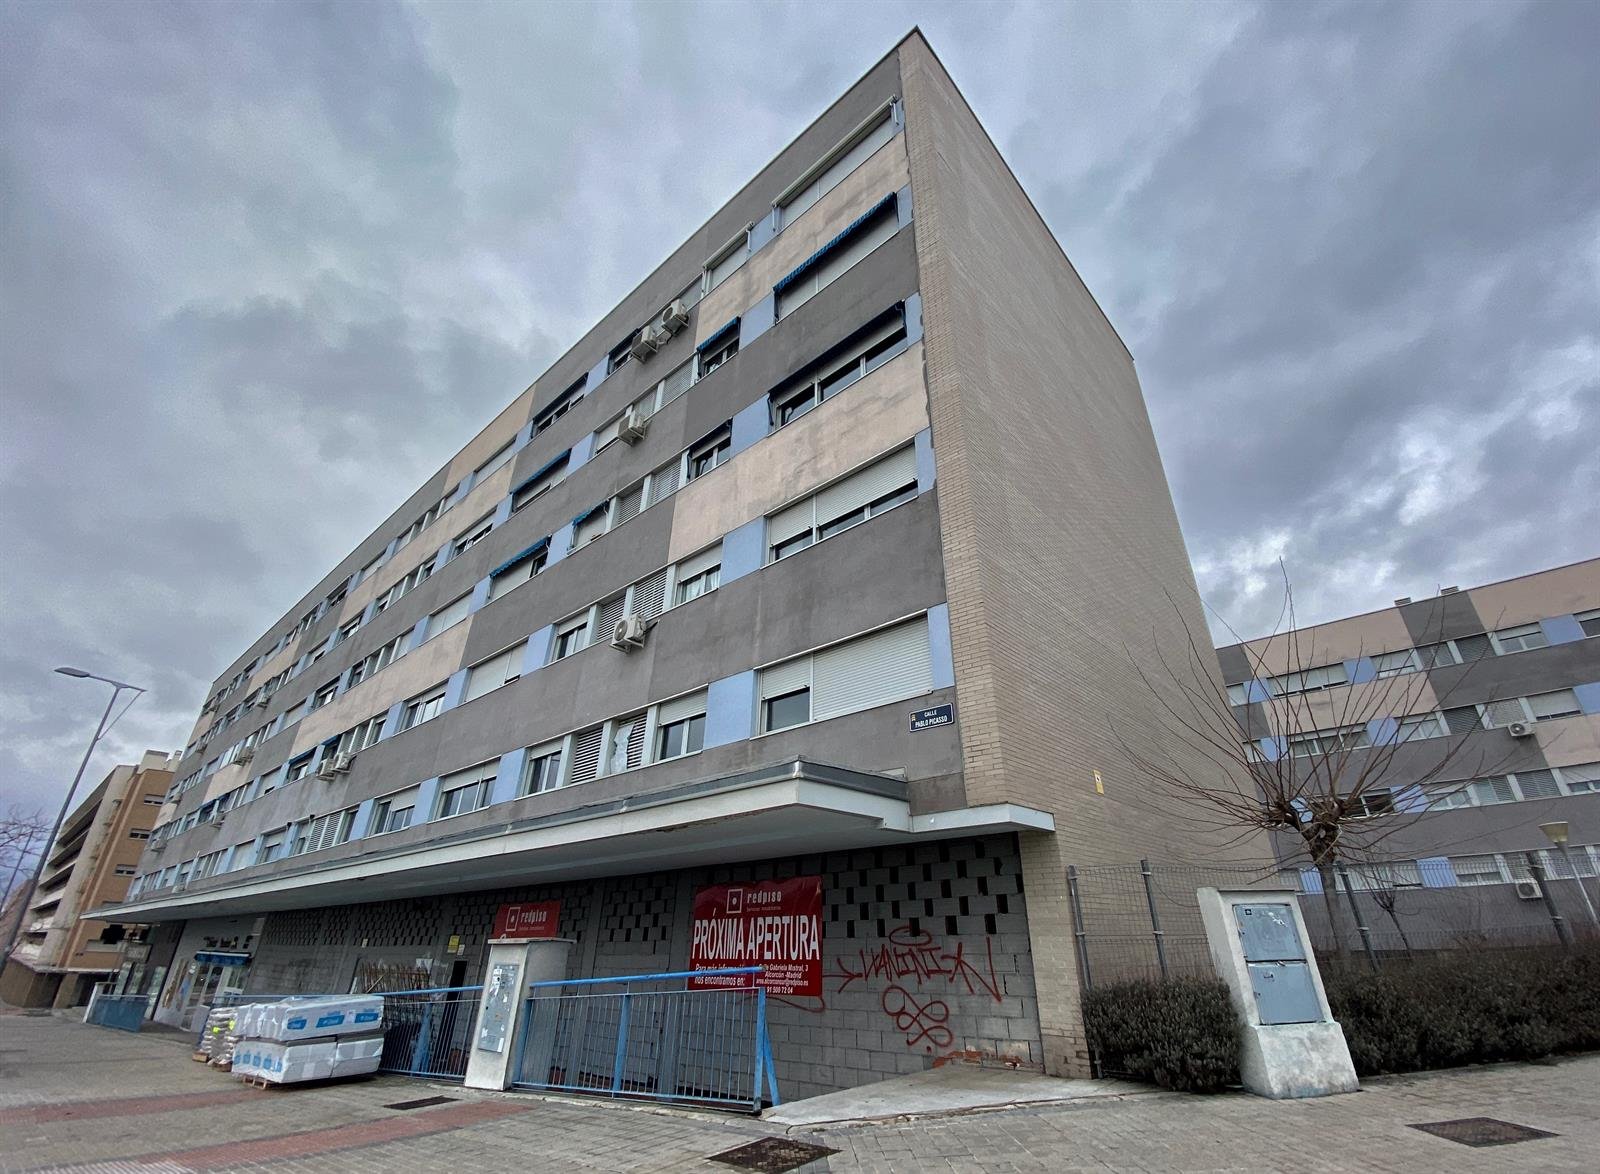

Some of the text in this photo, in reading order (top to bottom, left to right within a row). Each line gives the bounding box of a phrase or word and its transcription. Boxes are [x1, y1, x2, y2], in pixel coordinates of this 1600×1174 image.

[915, 715, 947, 728] PABLO PICASSO
[747, 890, 781, 904] redpiso
[520, 909, 547, 924] redpiso
[692, 907, 820, 960] PRÓXIMA APERTURA
[694, 976, 704, 985] nos
[705, 975, 736, 986] encontramos
